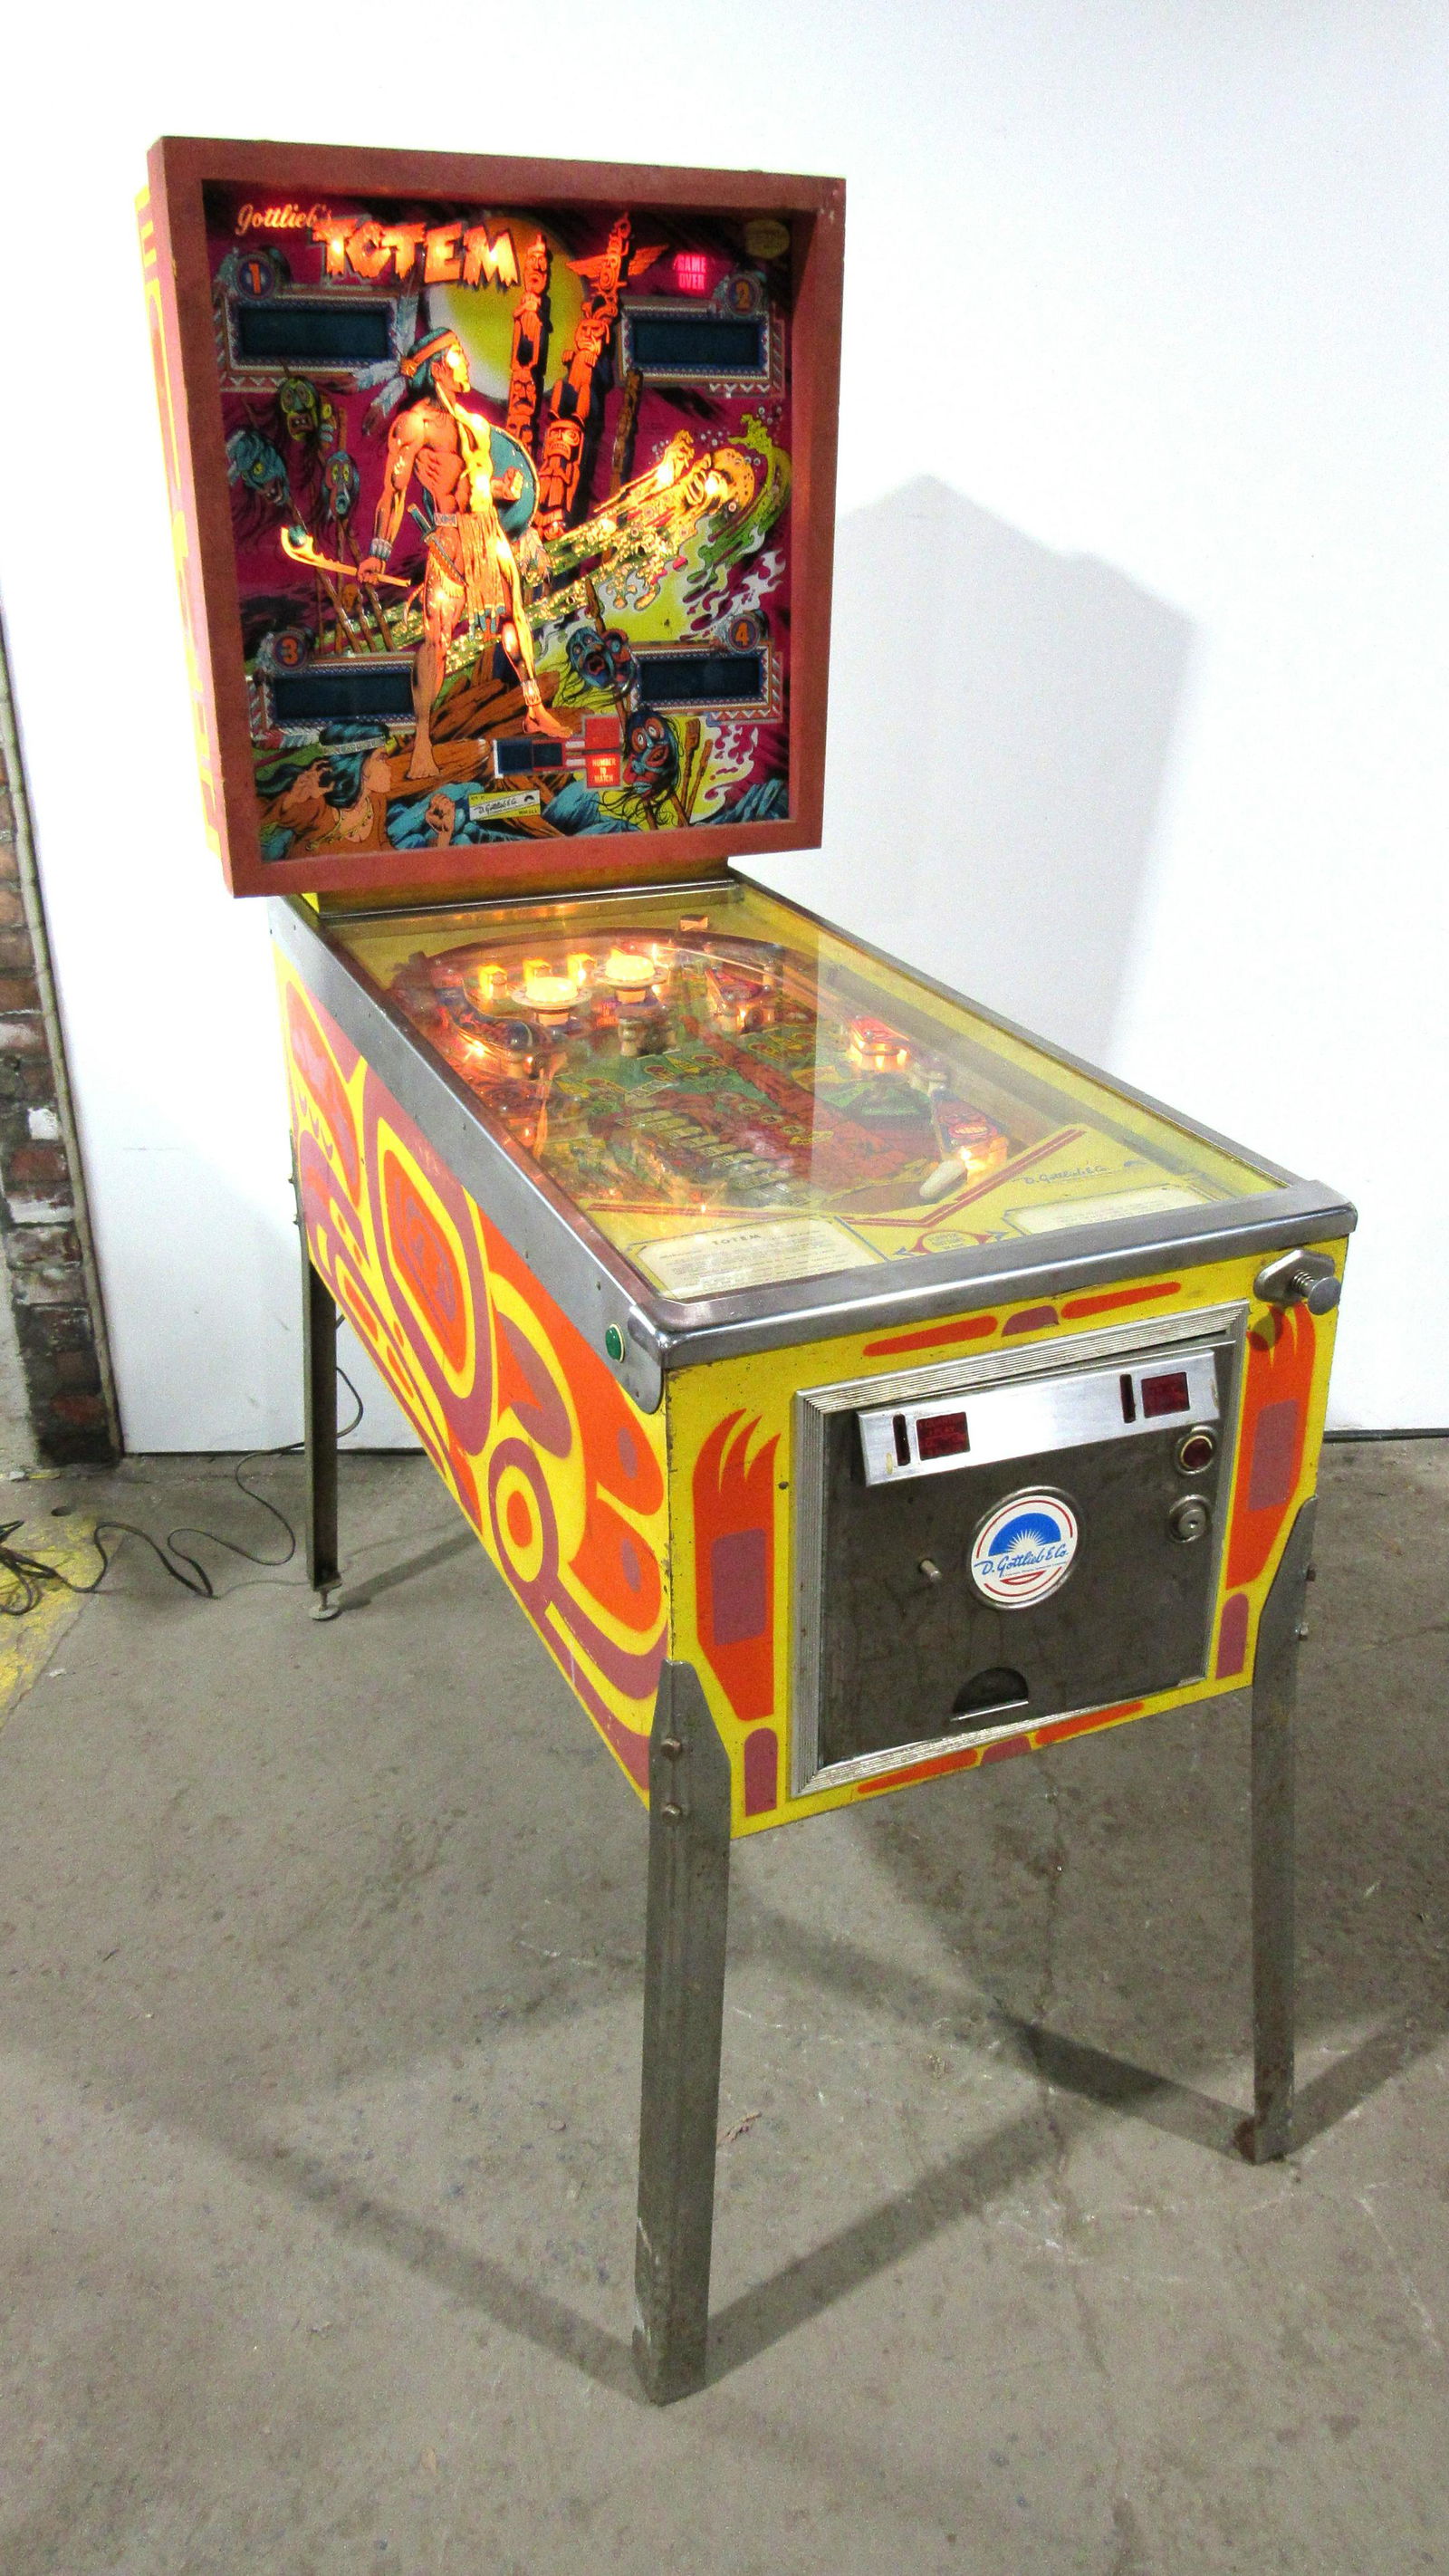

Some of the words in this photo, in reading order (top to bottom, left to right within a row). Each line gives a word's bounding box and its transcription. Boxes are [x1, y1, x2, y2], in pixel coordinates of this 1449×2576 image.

[312, 217, 519, 287] TOTEM
[677, 254, 706, 273] GAME
[248, 263, 262, 294] 1
[679, 273, 705, 290] OVER
[734, 280, 751, 310] 2
[735, 622, 750, 647] 4
[282, 638, 298, 666] 3
[974, 1560, 995, 1576] D.
[997, 1547, 1045, 1578] Gottlieb
